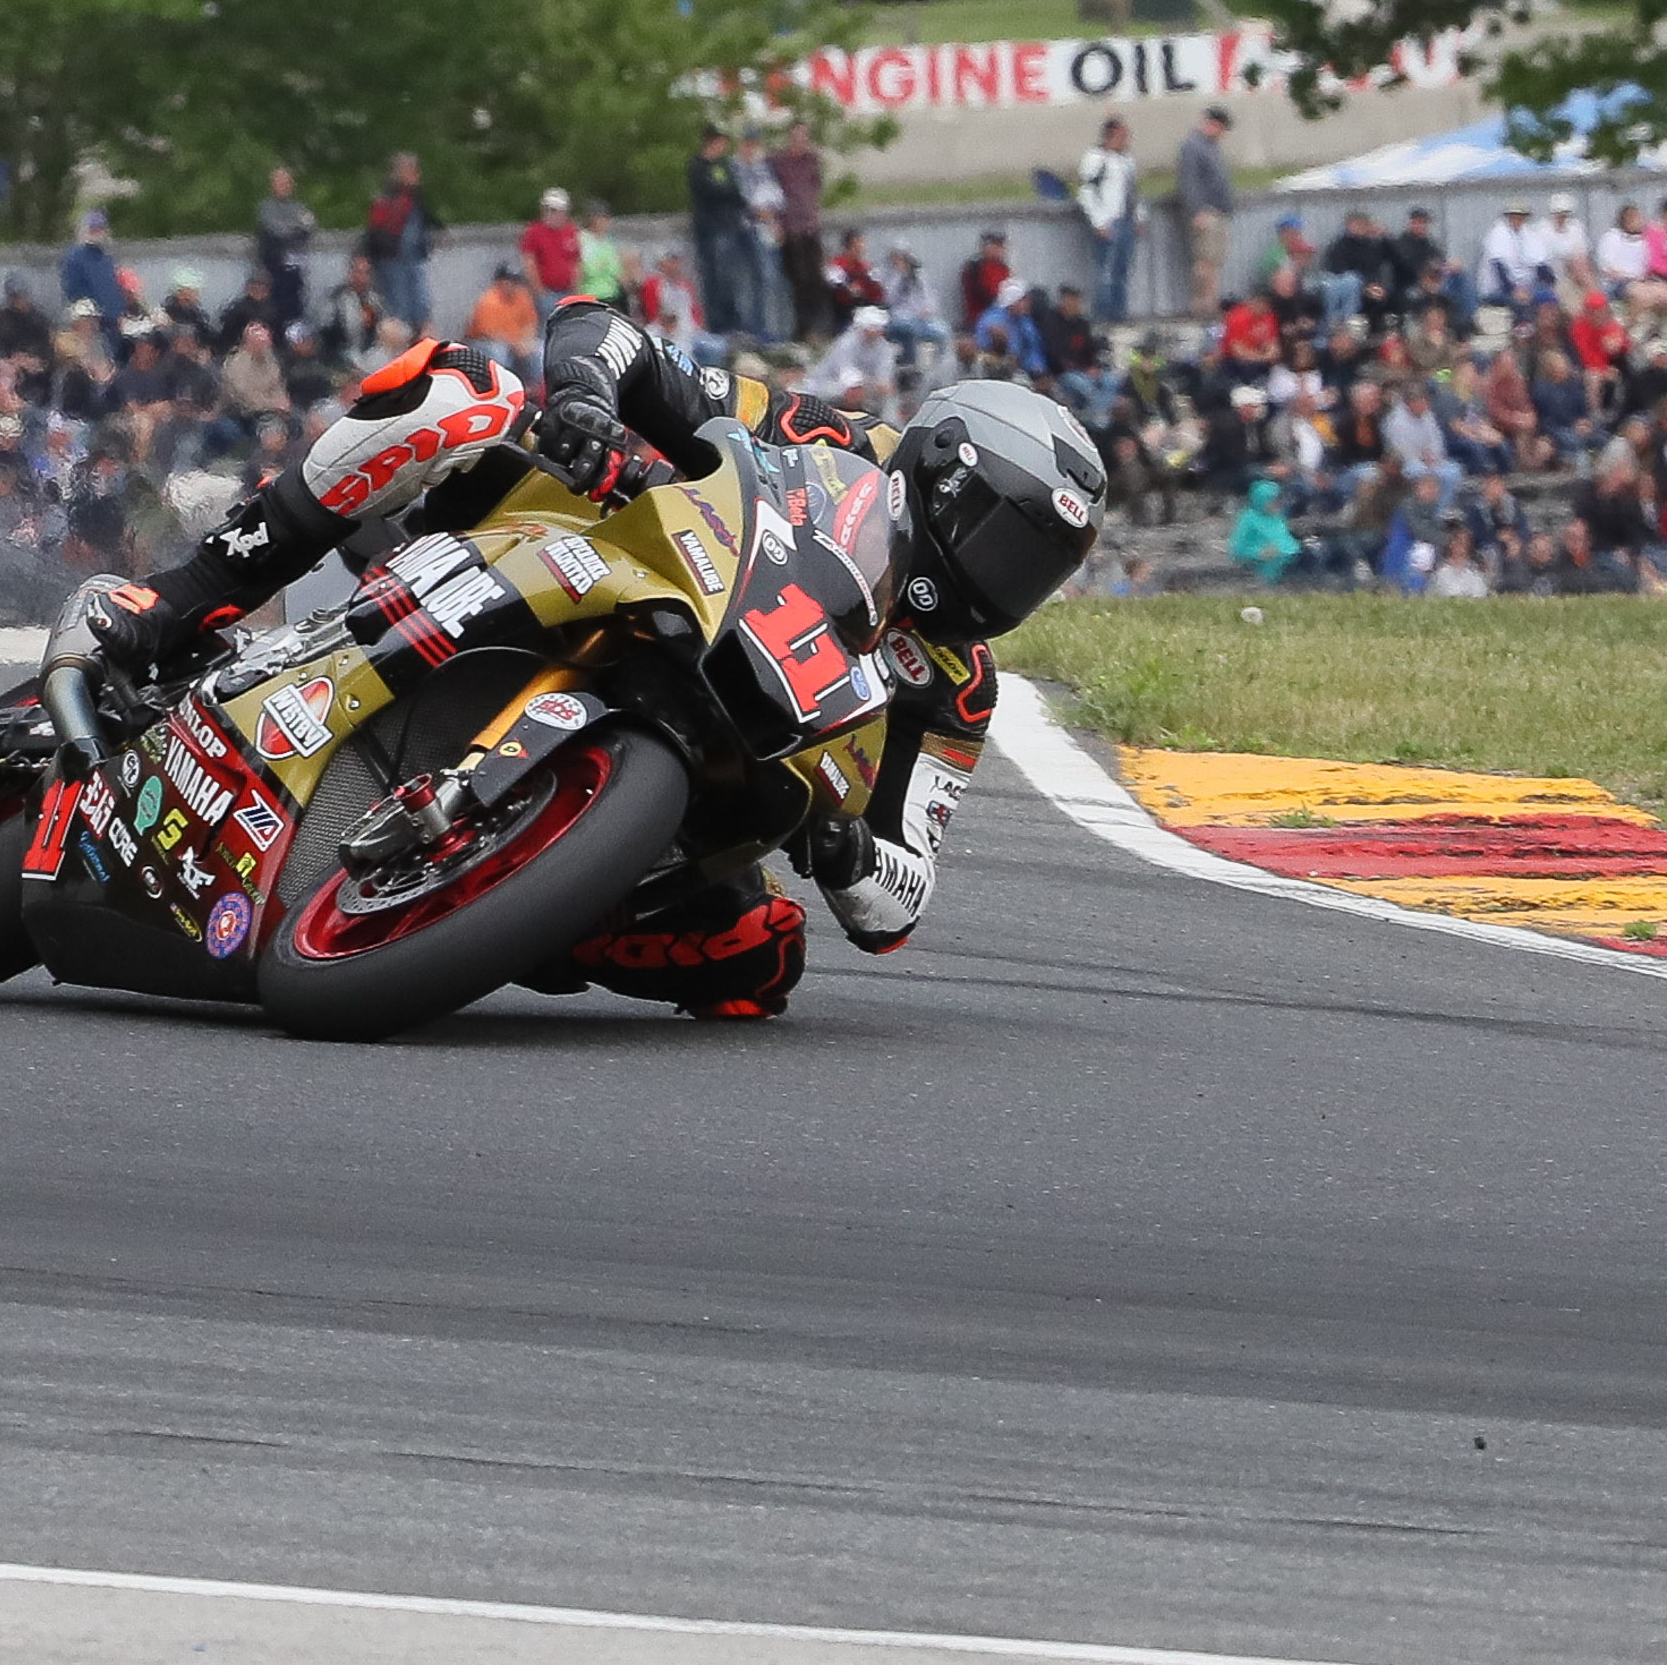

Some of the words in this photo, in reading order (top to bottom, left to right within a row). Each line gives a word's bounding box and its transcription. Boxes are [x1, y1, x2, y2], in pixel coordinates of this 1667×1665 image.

[1071, 41, 1195, 95] OIL
[890, 476, 902, 511] BELL
[1057, 492, 1086, 524] BELL
[219, 521, 271, 559] Xpd
[679, 531, 725, 593] YAMALUBE
[739, 582, 851, 724] 11
[889, 635, 926, 682] BELL
[271, 687, 323, 749] WESTBY
[163, 735, 236, 827] YAMAHA
